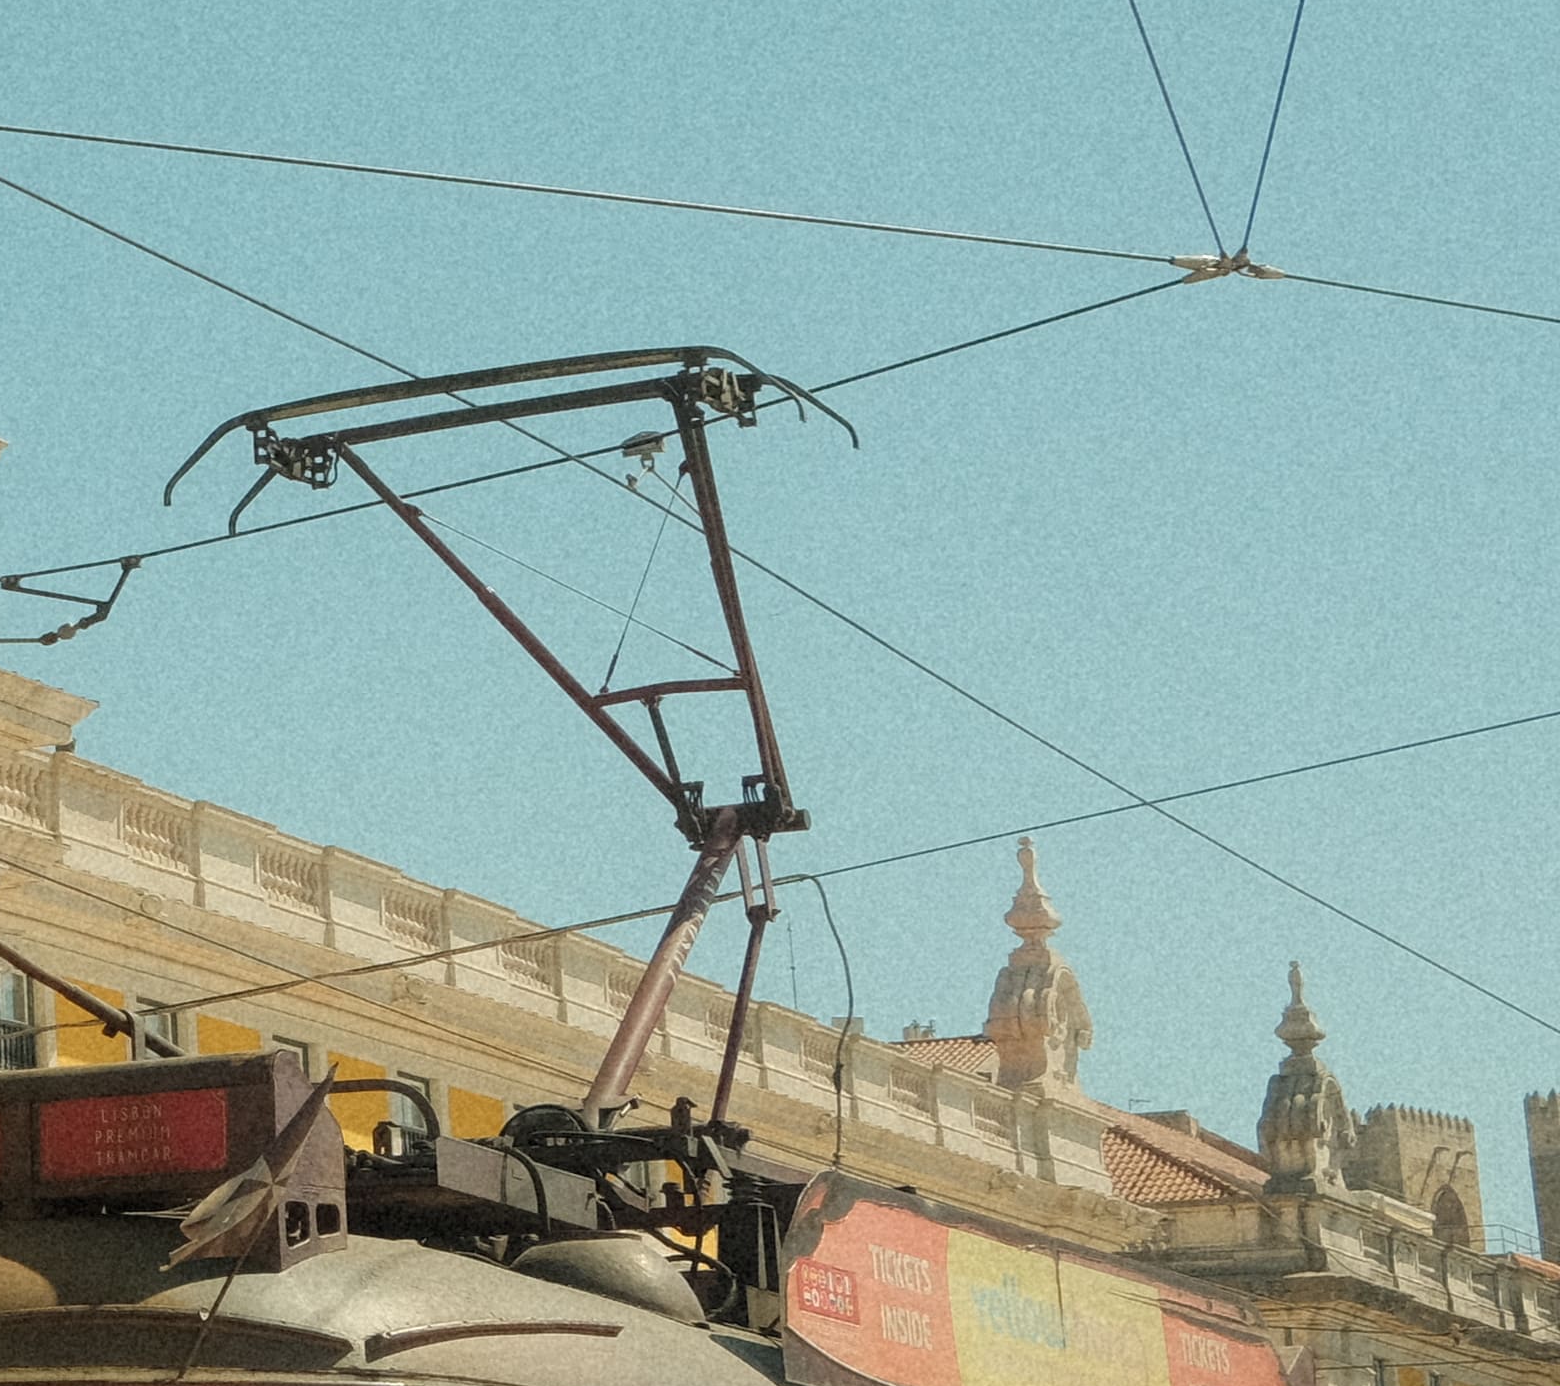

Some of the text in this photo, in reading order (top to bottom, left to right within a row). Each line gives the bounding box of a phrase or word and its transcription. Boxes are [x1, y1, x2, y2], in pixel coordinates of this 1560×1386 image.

[101, 1105, 163, 1124] LISBON
[95, 1126, 171, 1144] PREMIUM
[95, 1147, 172, 1166] TRAMCAR
[868, 1243, 933, 1295] TICKETS
[880, 1303, 933, 1351] INSIDE
[1179, 1332, 1231, 1376] TICKETS
